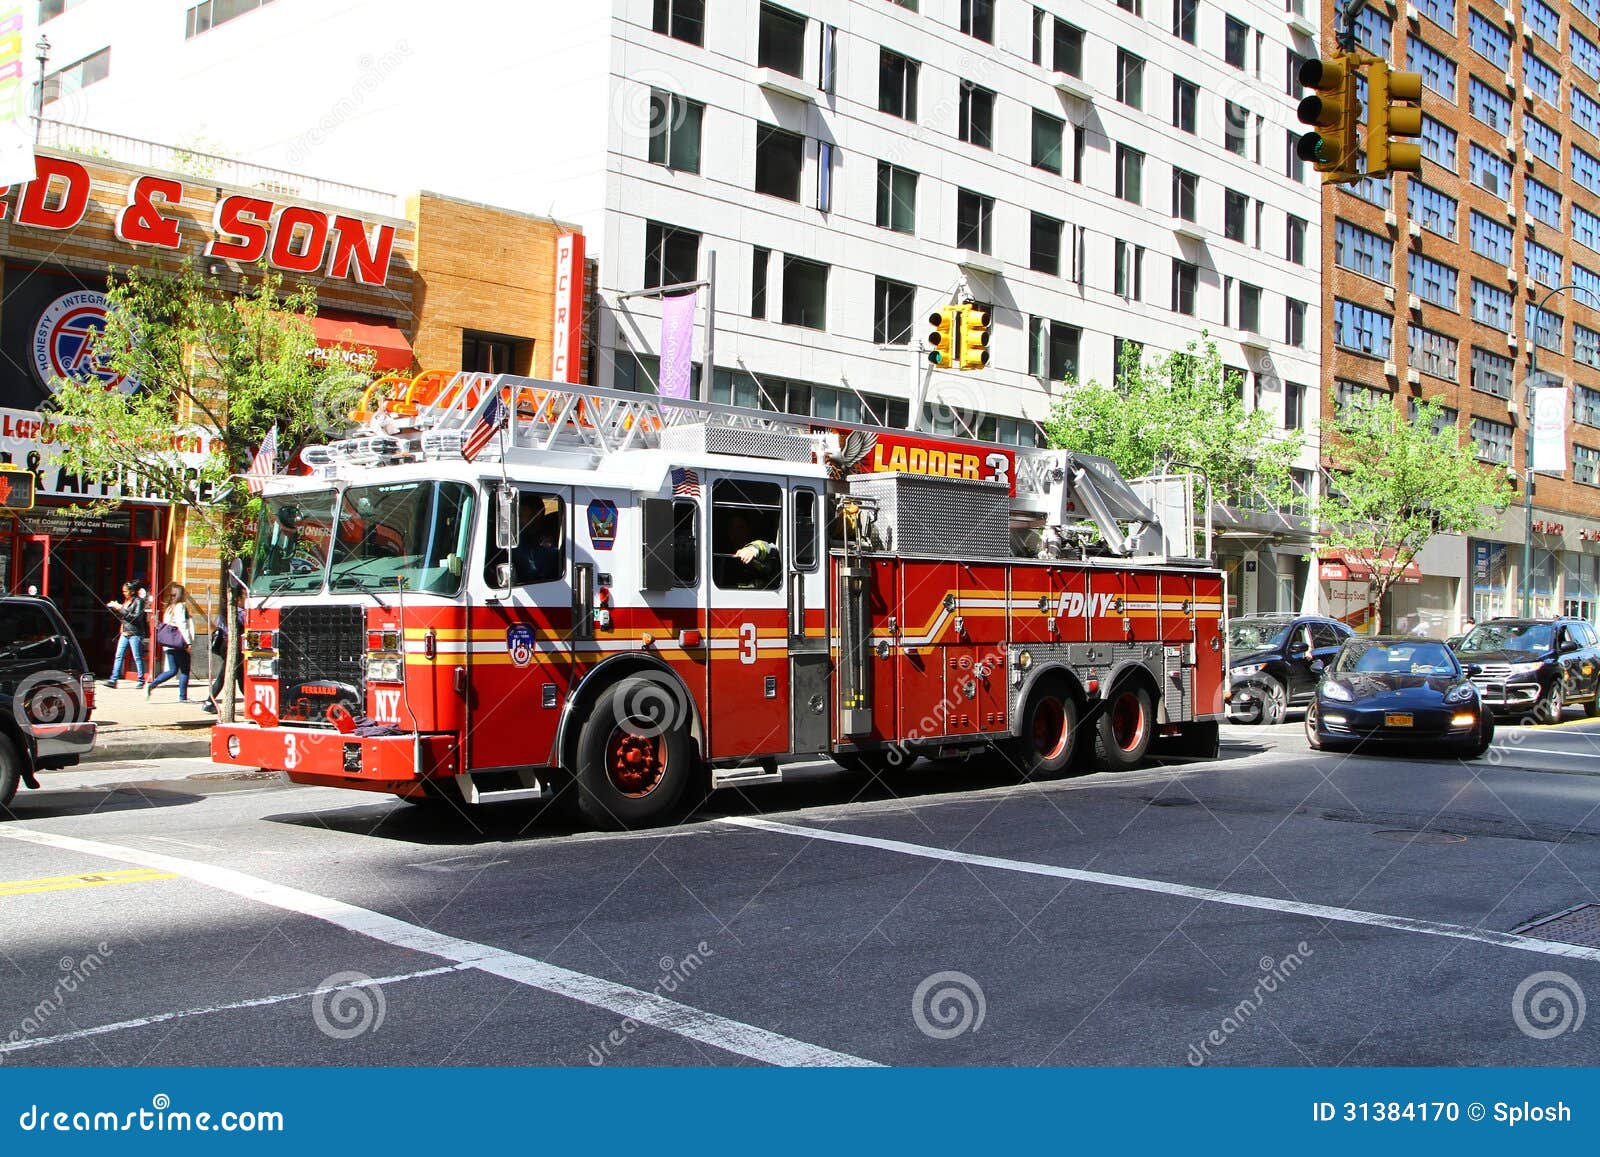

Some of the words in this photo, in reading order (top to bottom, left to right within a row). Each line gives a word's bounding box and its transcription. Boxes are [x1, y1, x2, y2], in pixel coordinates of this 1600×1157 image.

[115, 175, 184, 249] &
[203, 194, 397, 288] SON
[36, 315, 53, 371] HONESTY
[873, 443, 980, 480] LADDER
[985, 453, 1009, 483] 3
[1056, 592, 1114, 618] FDNY
[740, 622, 757, 665] 3
[284, 734, 297, 769] 3
